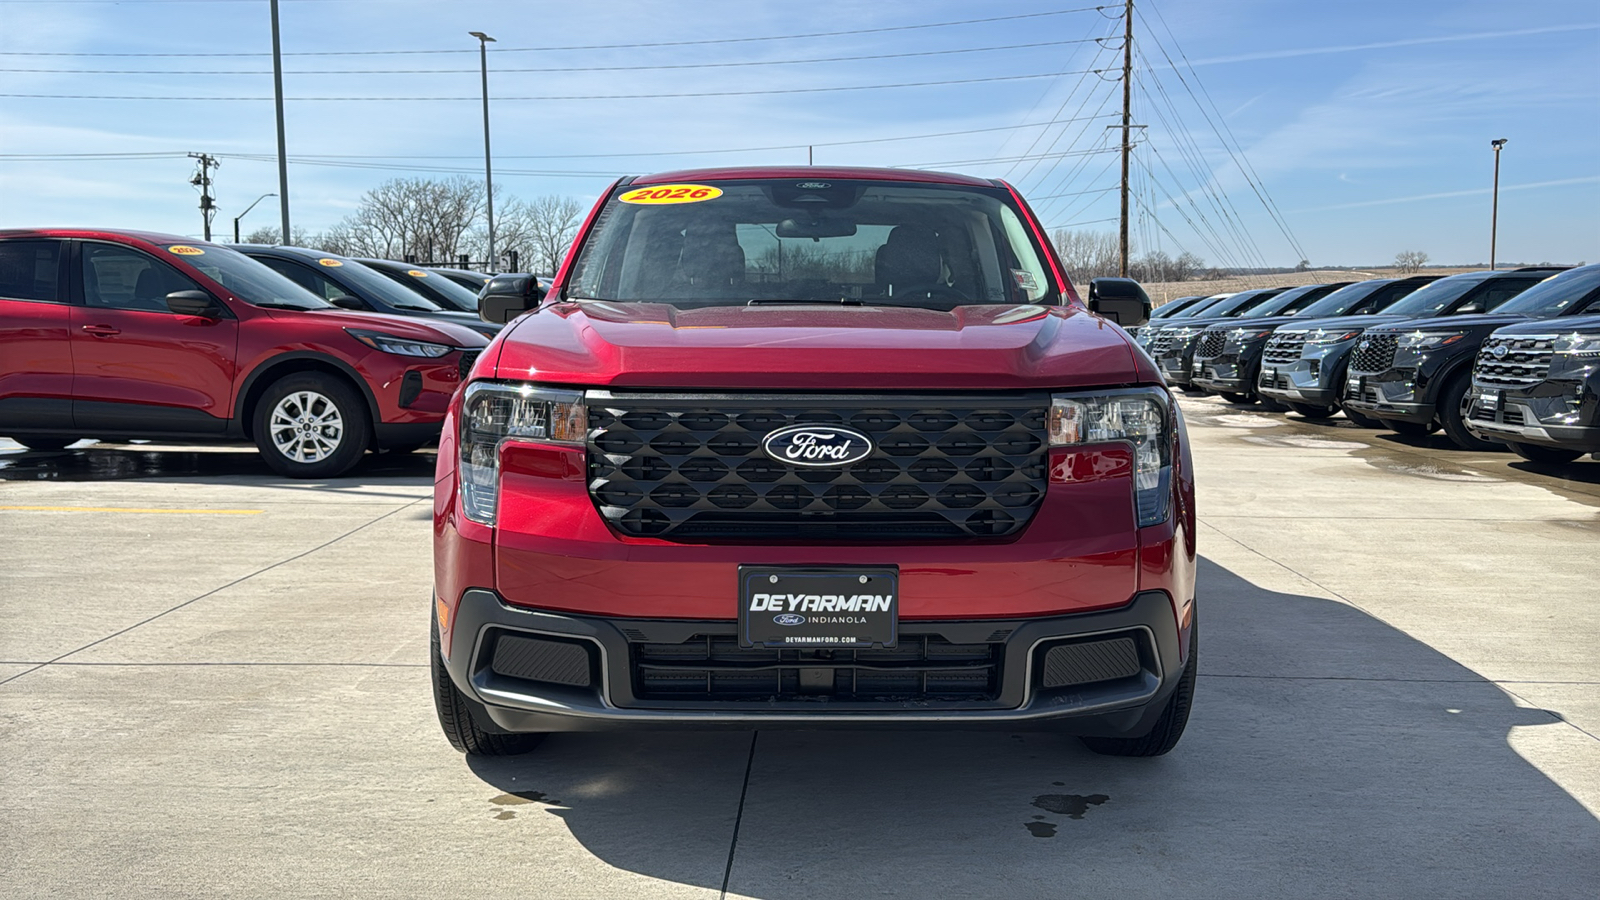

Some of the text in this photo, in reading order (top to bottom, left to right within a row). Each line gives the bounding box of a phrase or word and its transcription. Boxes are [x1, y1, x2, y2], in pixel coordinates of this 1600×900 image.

[628, 188, 712, 201] 2026
[785, 432, 851, 459] Ford
[749, 593, 893, 612] DEYARMAN
[779, 615, 867, 624] Ford INDIANOLA
